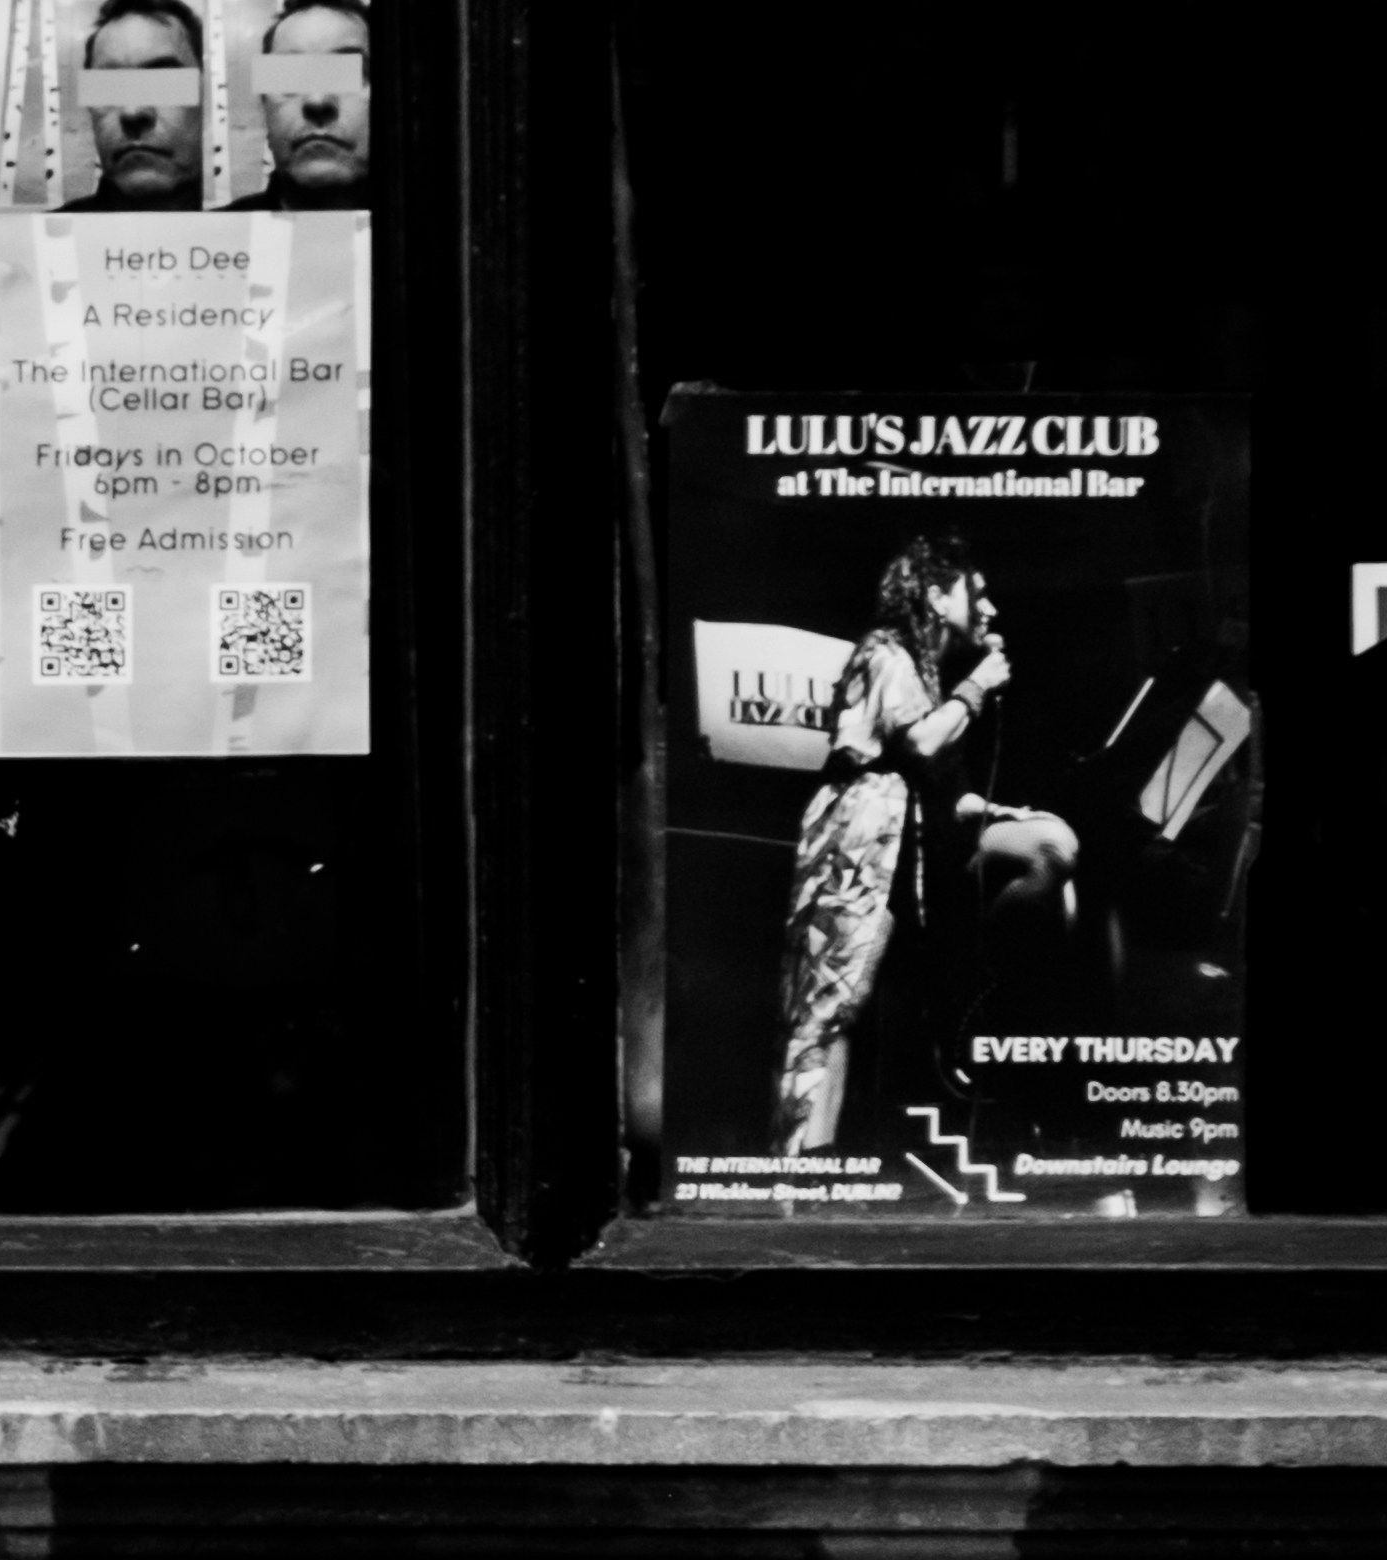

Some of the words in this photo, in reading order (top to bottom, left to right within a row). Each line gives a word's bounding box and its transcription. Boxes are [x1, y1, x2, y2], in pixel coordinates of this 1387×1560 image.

[104, 246, 178, 271] Herb
[189, 246, 251, 271] Dee
[82, 303, 102, 327] A
[113, 302, 275, 331] Residency
[13, 359, 69, 384] The
[81, 358, 277, 384] International
[289, 357, 344, 383] Bar
[88, 384, 190, 413] (Cellar
[201, 383, 268, 413] Bar)
[745, 412, 906, 457] LULU'S
[909, 414, 1027, 457] JAZZ
[1030, 414, 1161, 457] CLUB
[35, 442, 144, 471] Fridays
[156, 442, 183, 466] in
[194, 442, 320, 467] October
[93, 472, 159, 500] 6pm
[194, 470, 261, 500] 8pm
[775, 471, 811, 498] at
[814, 467, 876, 498] The
[878, 467, 1083, 498] International
[1086, 469, 1146, 498] Bar
[59, 526, 127, 552] Free
[137, 526, 294, 552] Admission
[972, 1036, 1069, 1063] EVERY
[1073, 1036, 1240, 1063] THURSDAY
[1086, 1080, 1151, 1103] Doors
[1155, 1080, 1240, 1108] 8.30pm
[1120, 1118, 1185, 1139] Music
[1188, 1117, 1240, 1145] 9pm
[676, 1156, 710, 1175] THE
[710, 1156, 844, 1175] INTERNATIONAL
[844, 1156, 883, 1175] BAR
[1013, 1152, 1149, 1176] Downstairs
[1151, 1153, 1241, 1182] Lounge
